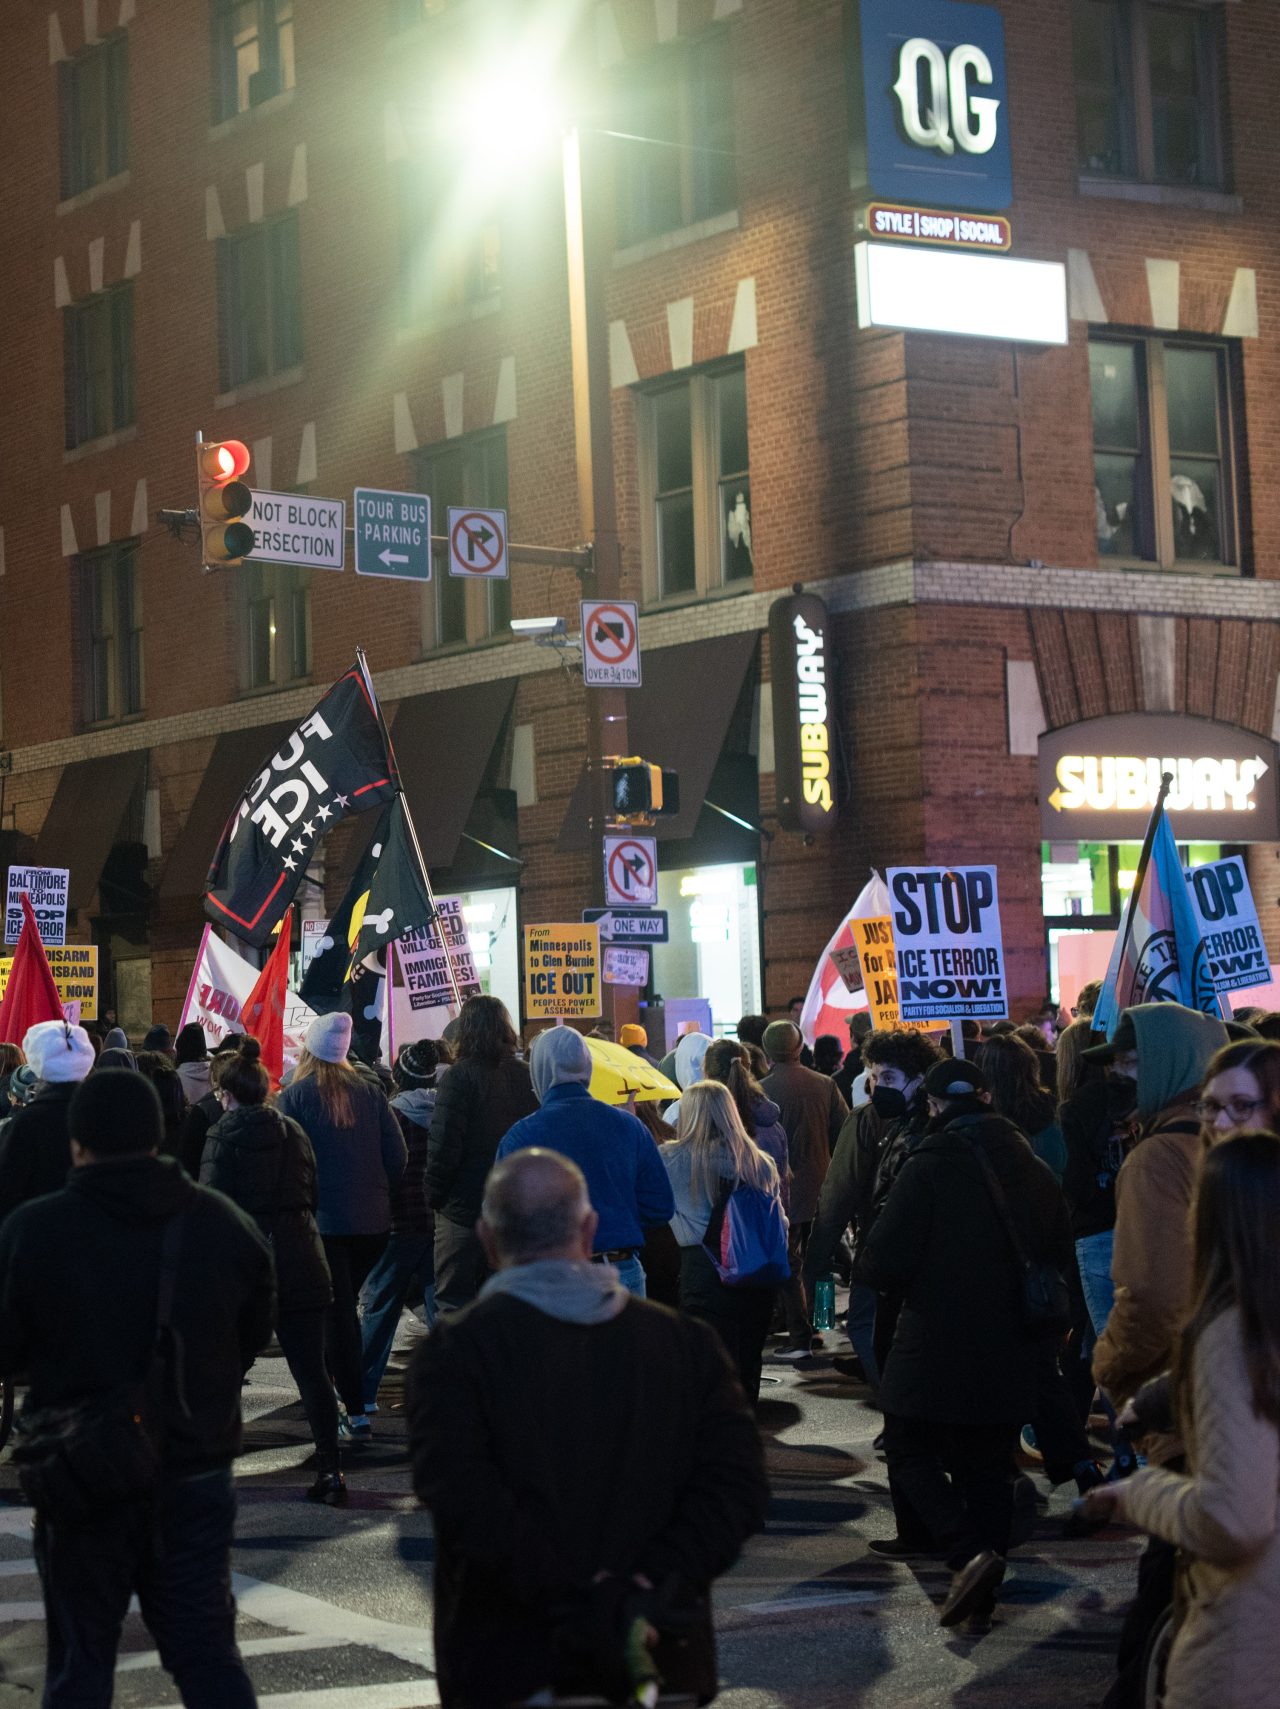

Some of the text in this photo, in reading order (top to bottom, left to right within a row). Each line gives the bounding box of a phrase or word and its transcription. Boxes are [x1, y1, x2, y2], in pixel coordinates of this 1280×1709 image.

[893, 37, 1001, 155] QG
[253, 501, 338, 529] NOT BLOCK
[358, 499, 426, 524] TOUR BUS
[365, 523, 421, 546] PARKING
[588, 668, 609, 680] OVER
[622, 668, 638, 680] TON
[793, 614, 834, 812] SUBWAY
[1048, 754, 1269, 812] SUBWAY
[9, 873, 67, 890] BALTIMORE
[1185, 862, 1244, 922] OP
[892, 870, 993, 936] STOP
[7, 908, 65, 919] SOP
[7, 920, 22, 935] ICE
[304, 921, 315, 930] NO
[529, 928, 550, 938] From
[614, 919, 661, 933] ONE WAY
[400, 933, 467, 955] WILL DEEND
[530, 939, 592, 954] Minneapolis
[530, 954, 595, 968] to Glen Burnie
[863, 952, 883, 973] for
[897, 947, 1000, 978] ICE TERROR
[50, 965, 95, 978] ISBAND
[408, 966, 475, 991] FAMILES!
[66, 985, 95, 998] NOW
[530, 972, 595, 995] ICE OUT
[901, 978, 1003, 1000] NOW!
[533, 998, 596, 1007] PEOPLES POWER
[544, 1006, 585, 1015] ASSEMBLY
[903, 1006, 920, 1017] PARTY
[922, 1005, 935, 1015] FOR
[935, 1004, 965, 1015] SOCIALISM
[971, 1003, 1004, 1014] LIBERATION
